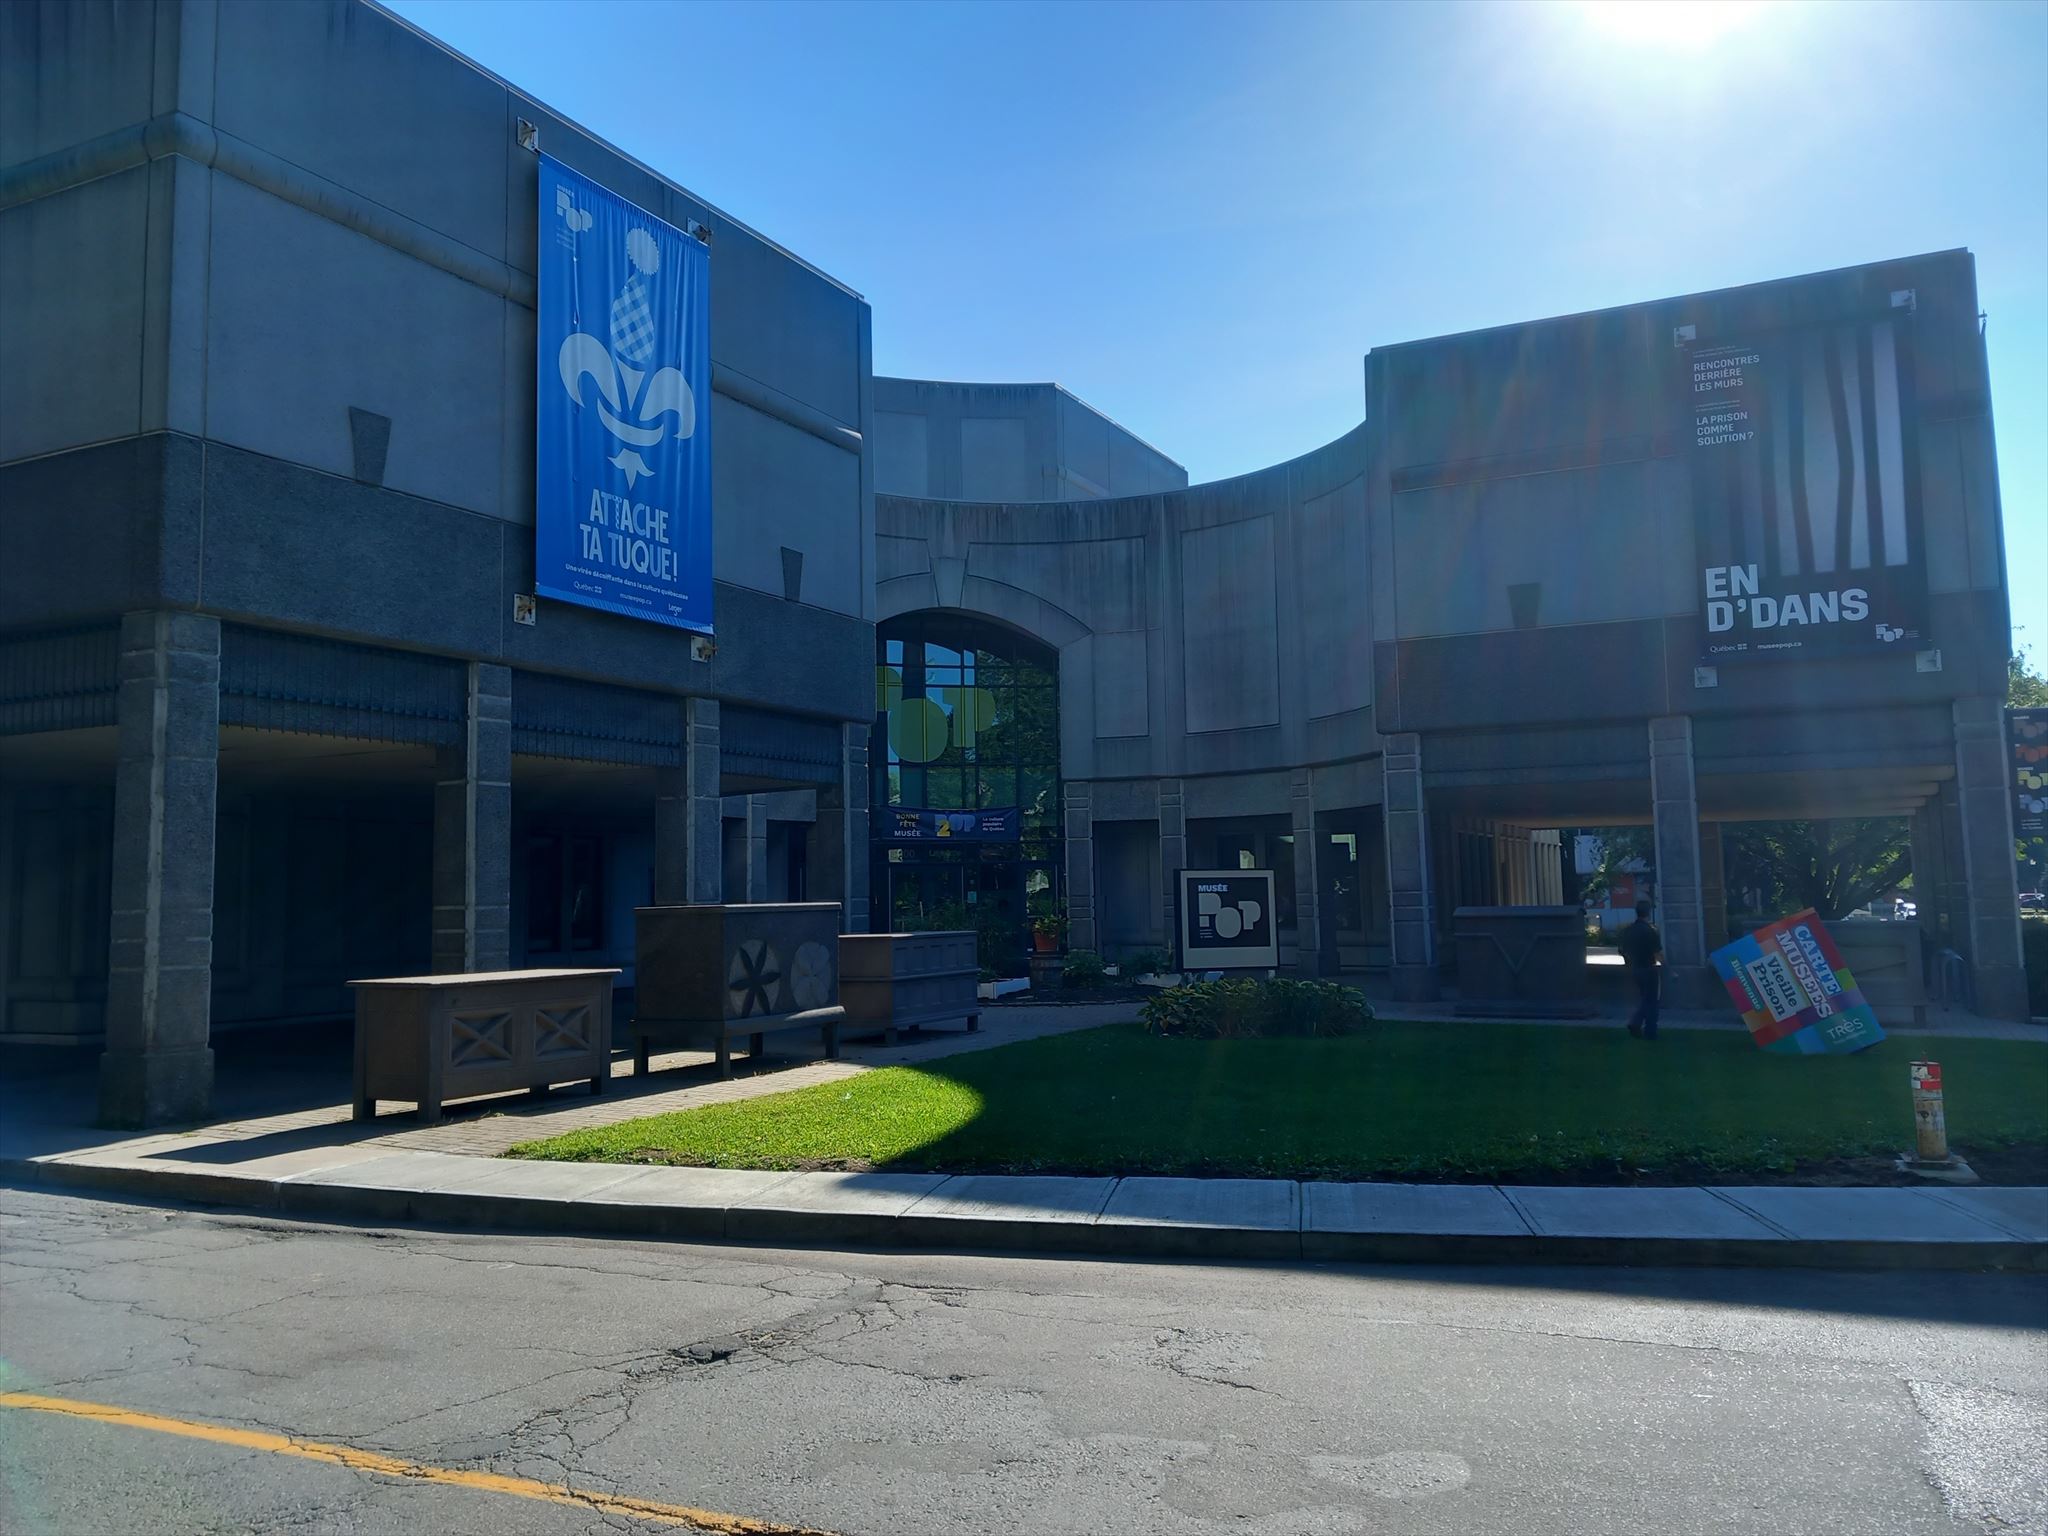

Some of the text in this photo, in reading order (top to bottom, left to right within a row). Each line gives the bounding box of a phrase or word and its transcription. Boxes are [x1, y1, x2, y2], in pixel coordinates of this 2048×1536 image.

[1694, 354, 1760, 372] RENCONTRES
[1694, 367, 1742, 382] DERRIÈRE
[1694, 378, 1744, 392] LES MURS
[1696, 411, 1748, 426] LA PRISON
[1697, 424, 1734, 436] COMME
[590, 488, 669, 544] ATTACHE
[580, 523, 678, 583] TA TUQUE!
[566, 563, 577, 571] Une
[577, 566, 592, 576] virée
[592, 570, 624, 584] décoiffante
[624, 578, 636, 588] dans
[642, 584, 660, 594] culture
[573, 580, 594, 592] Québec
[1706, 564, 1759, 598] EN
[1710, 644, 1737, 653] Québec
[1758, 640, 1802, 650] museepop.ca
[894, 829, 921, 837] MUSÉE
[900, 820, 916, 828] FÊTE
[1198, 883, 1228, 892] MUSÉE
[1199, 893, 1261, 938] POP
[1793, 925, 1842, 995] CARTE
[1767, 956, 1798, 1008] Vieille
[1776, 930, 1833, 1018] MUSÉES
[1731, 959, 1761, 1011] Bienvenue
[1753, 963, 1786, 1015] Prison
